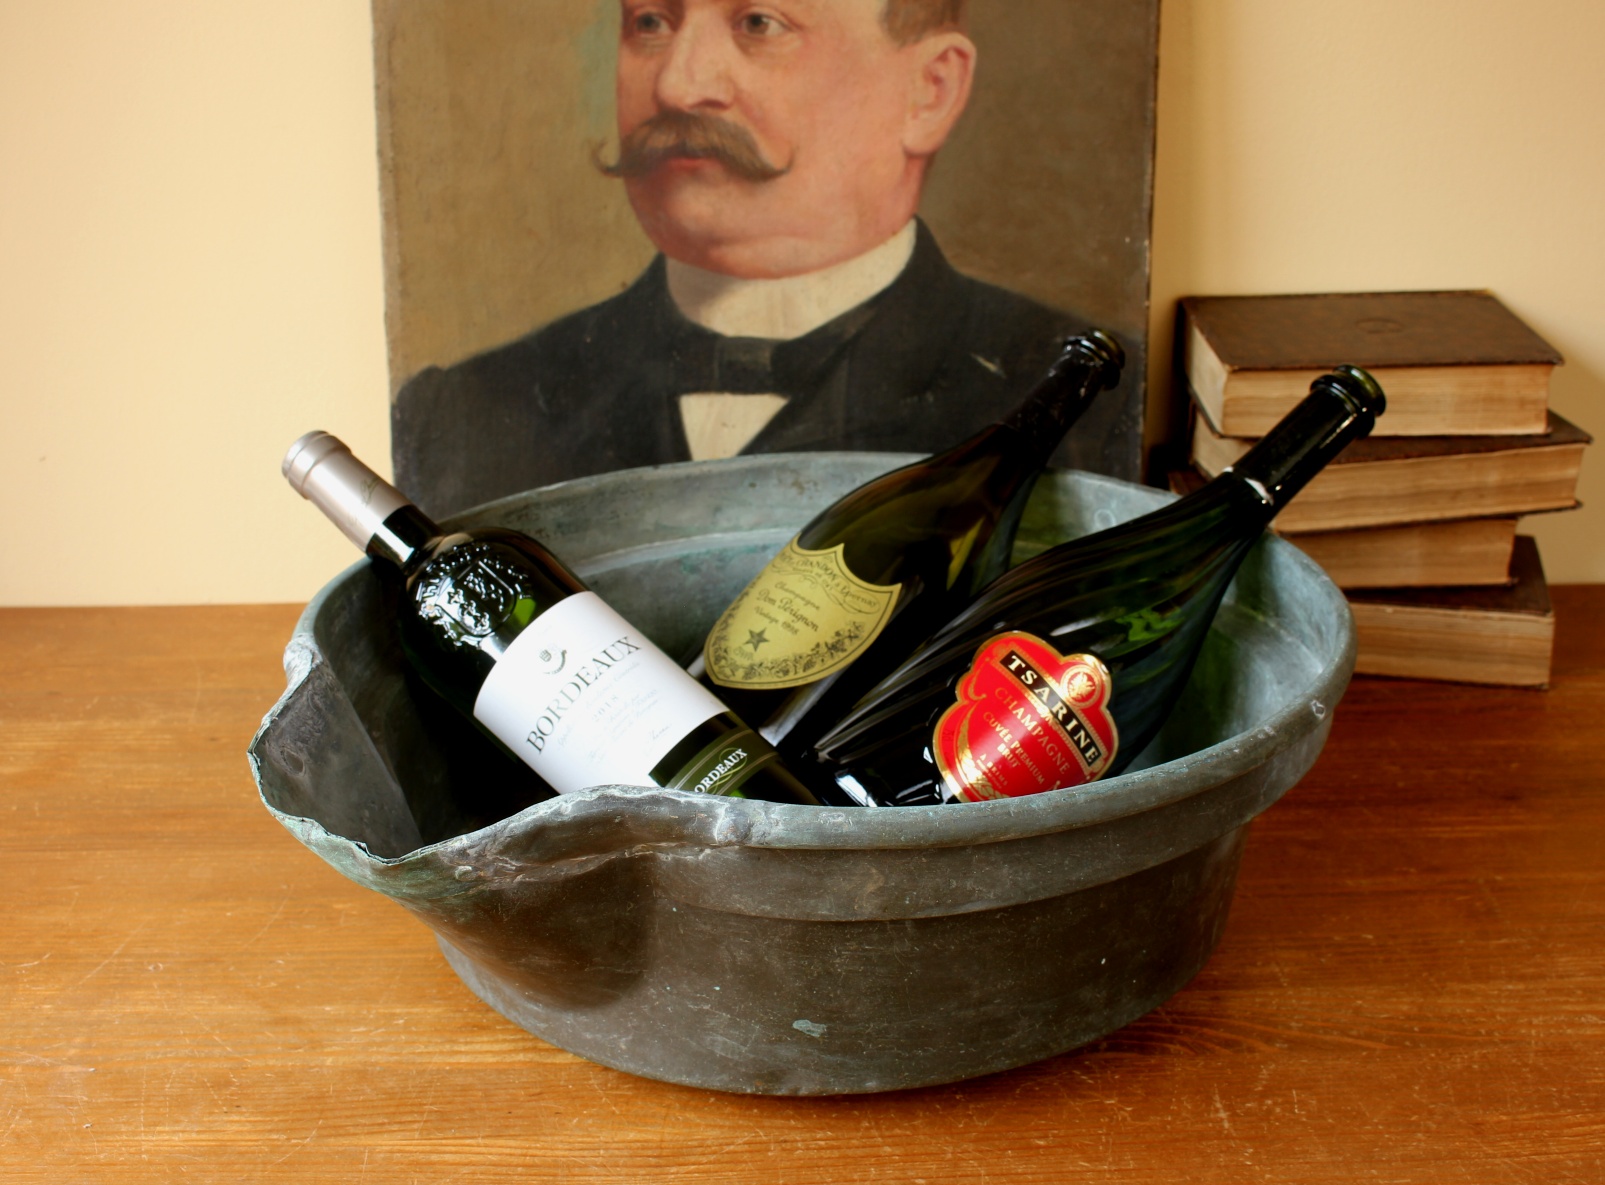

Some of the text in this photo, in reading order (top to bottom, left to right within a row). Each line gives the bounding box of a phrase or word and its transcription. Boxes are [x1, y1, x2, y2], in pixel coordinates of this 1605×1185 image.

[757, 588, 819, 632] Dom Pérignon
[775, 581, 820, 610] Champagne
[526, 636, 642, 754] BORDEAUX
[1008, 655, 1097, 763] TSARINE
[983, 711, 1012, 745] CUVÉE
[994, 686, 1071, 775] CHAMPAGNE
[694, 748, 747, 793] ORDEAUX
[997, 743, 1020, 768] BRUT
